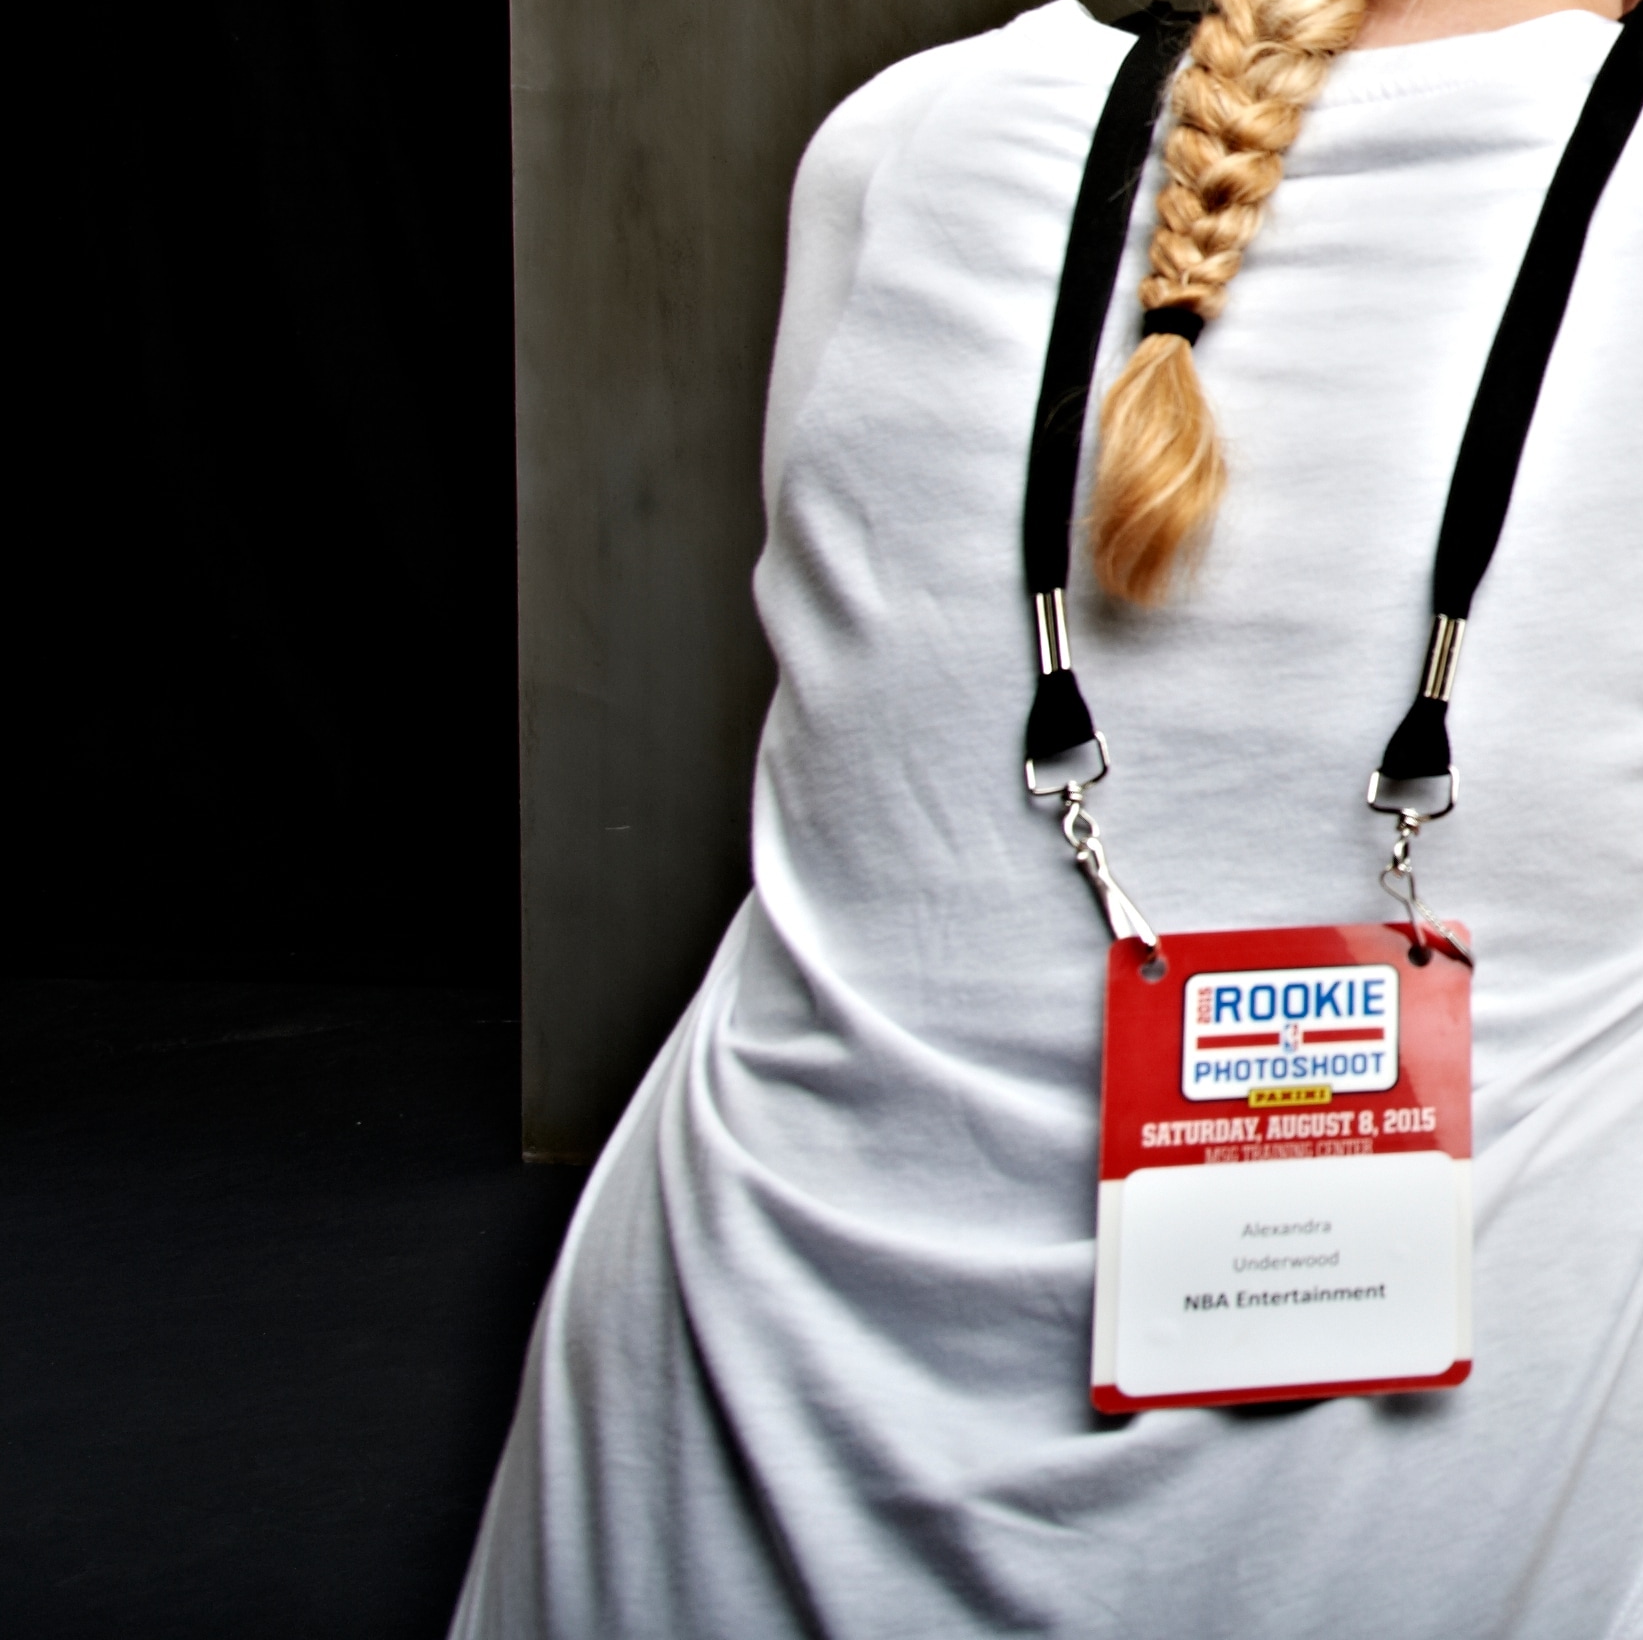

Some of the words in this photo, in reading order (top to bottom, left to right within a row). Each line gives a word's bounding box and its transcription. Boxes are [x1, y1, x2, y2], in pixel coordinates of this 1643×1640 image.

[1214, 978, 1386, 1023] ROOKIE
[1194, 1052, 1386, 1083] PHOTOSHOOT
[1255, 1089, 1327, 1103] PANINI
[1141, 1117, 1263, 1148] SATURDAY,
[1265, 1113, 1354, 1140] AUGUST
[1358, 1110, 1379, 1137] 8,
[1383, 1107, 1436, 1134] 2015
[1242, 1219, 1332, 1238] Alexandra
[1232, 1250, 1340, 1273] Underwood
[1183, 1292, 1230, 1312] NBA
[1237, 1284, 1385, 1308] Entertainment
